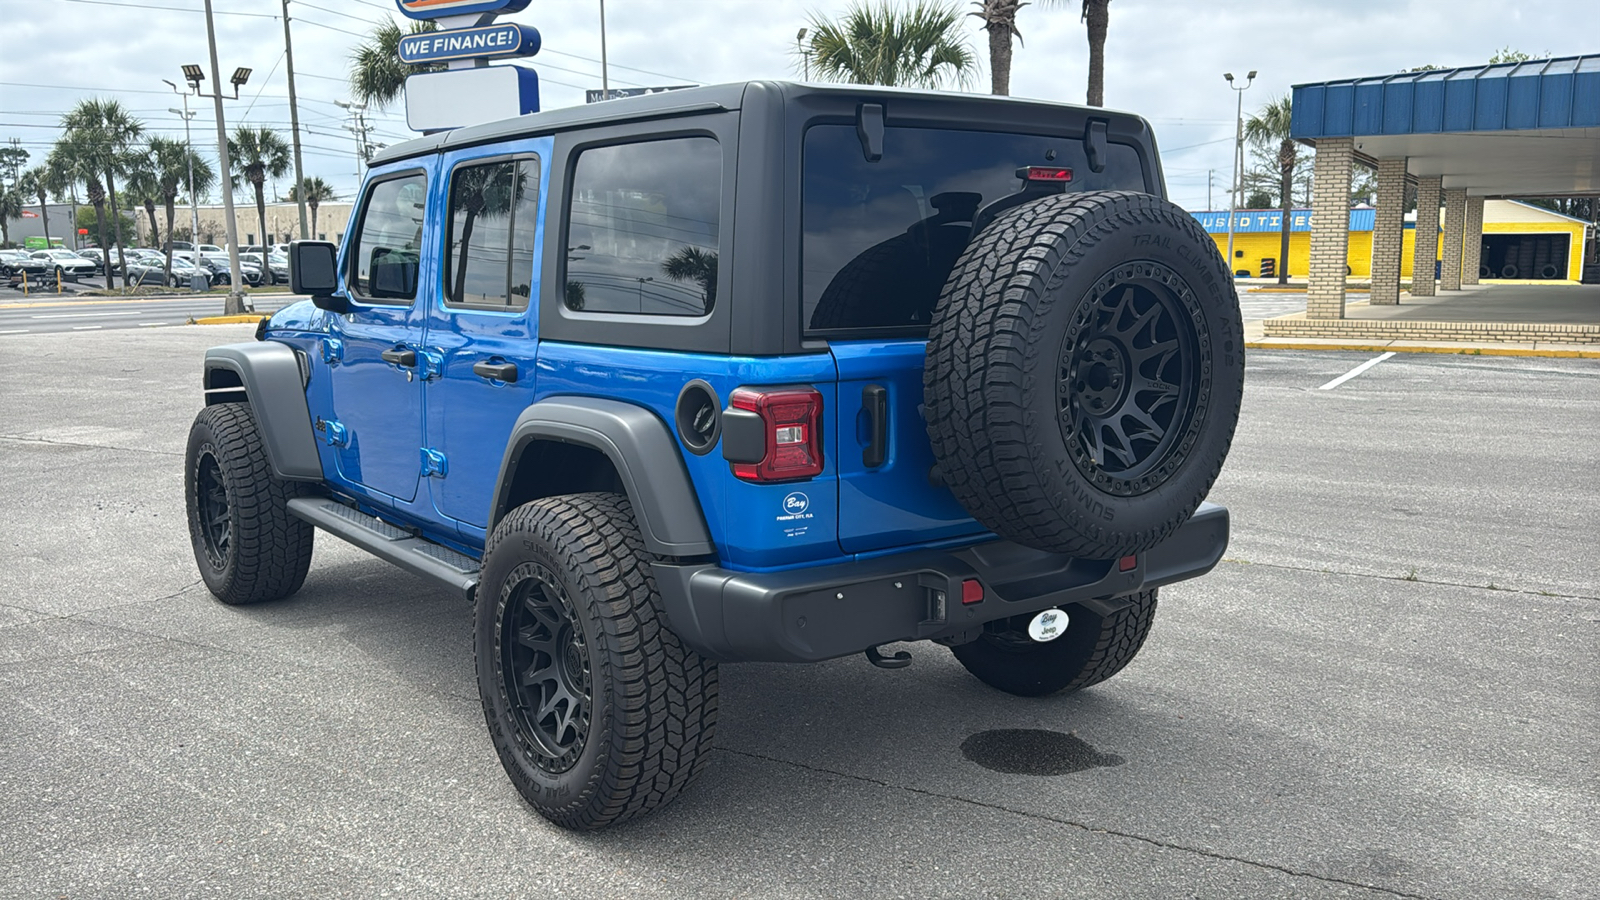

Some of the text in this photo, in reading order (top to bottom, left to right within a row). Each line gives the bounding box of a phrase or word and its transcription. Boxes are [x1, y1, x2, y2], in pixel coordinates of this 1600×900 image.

[404, 31, 513, 56] WE FINANCE!
[1202, 216, 1313, 227] USED TIE
[1131, 234, 1171, 249] TRAIL
[1177, 244, 1225, 307] CLIMBER
[1055, 459, 1115, 522] SUMMIT
[787, 497, 805, 509] Bay
[1041, 613, 1057, 623] Bay
[1041, 627, 1057, 635] Jeep
